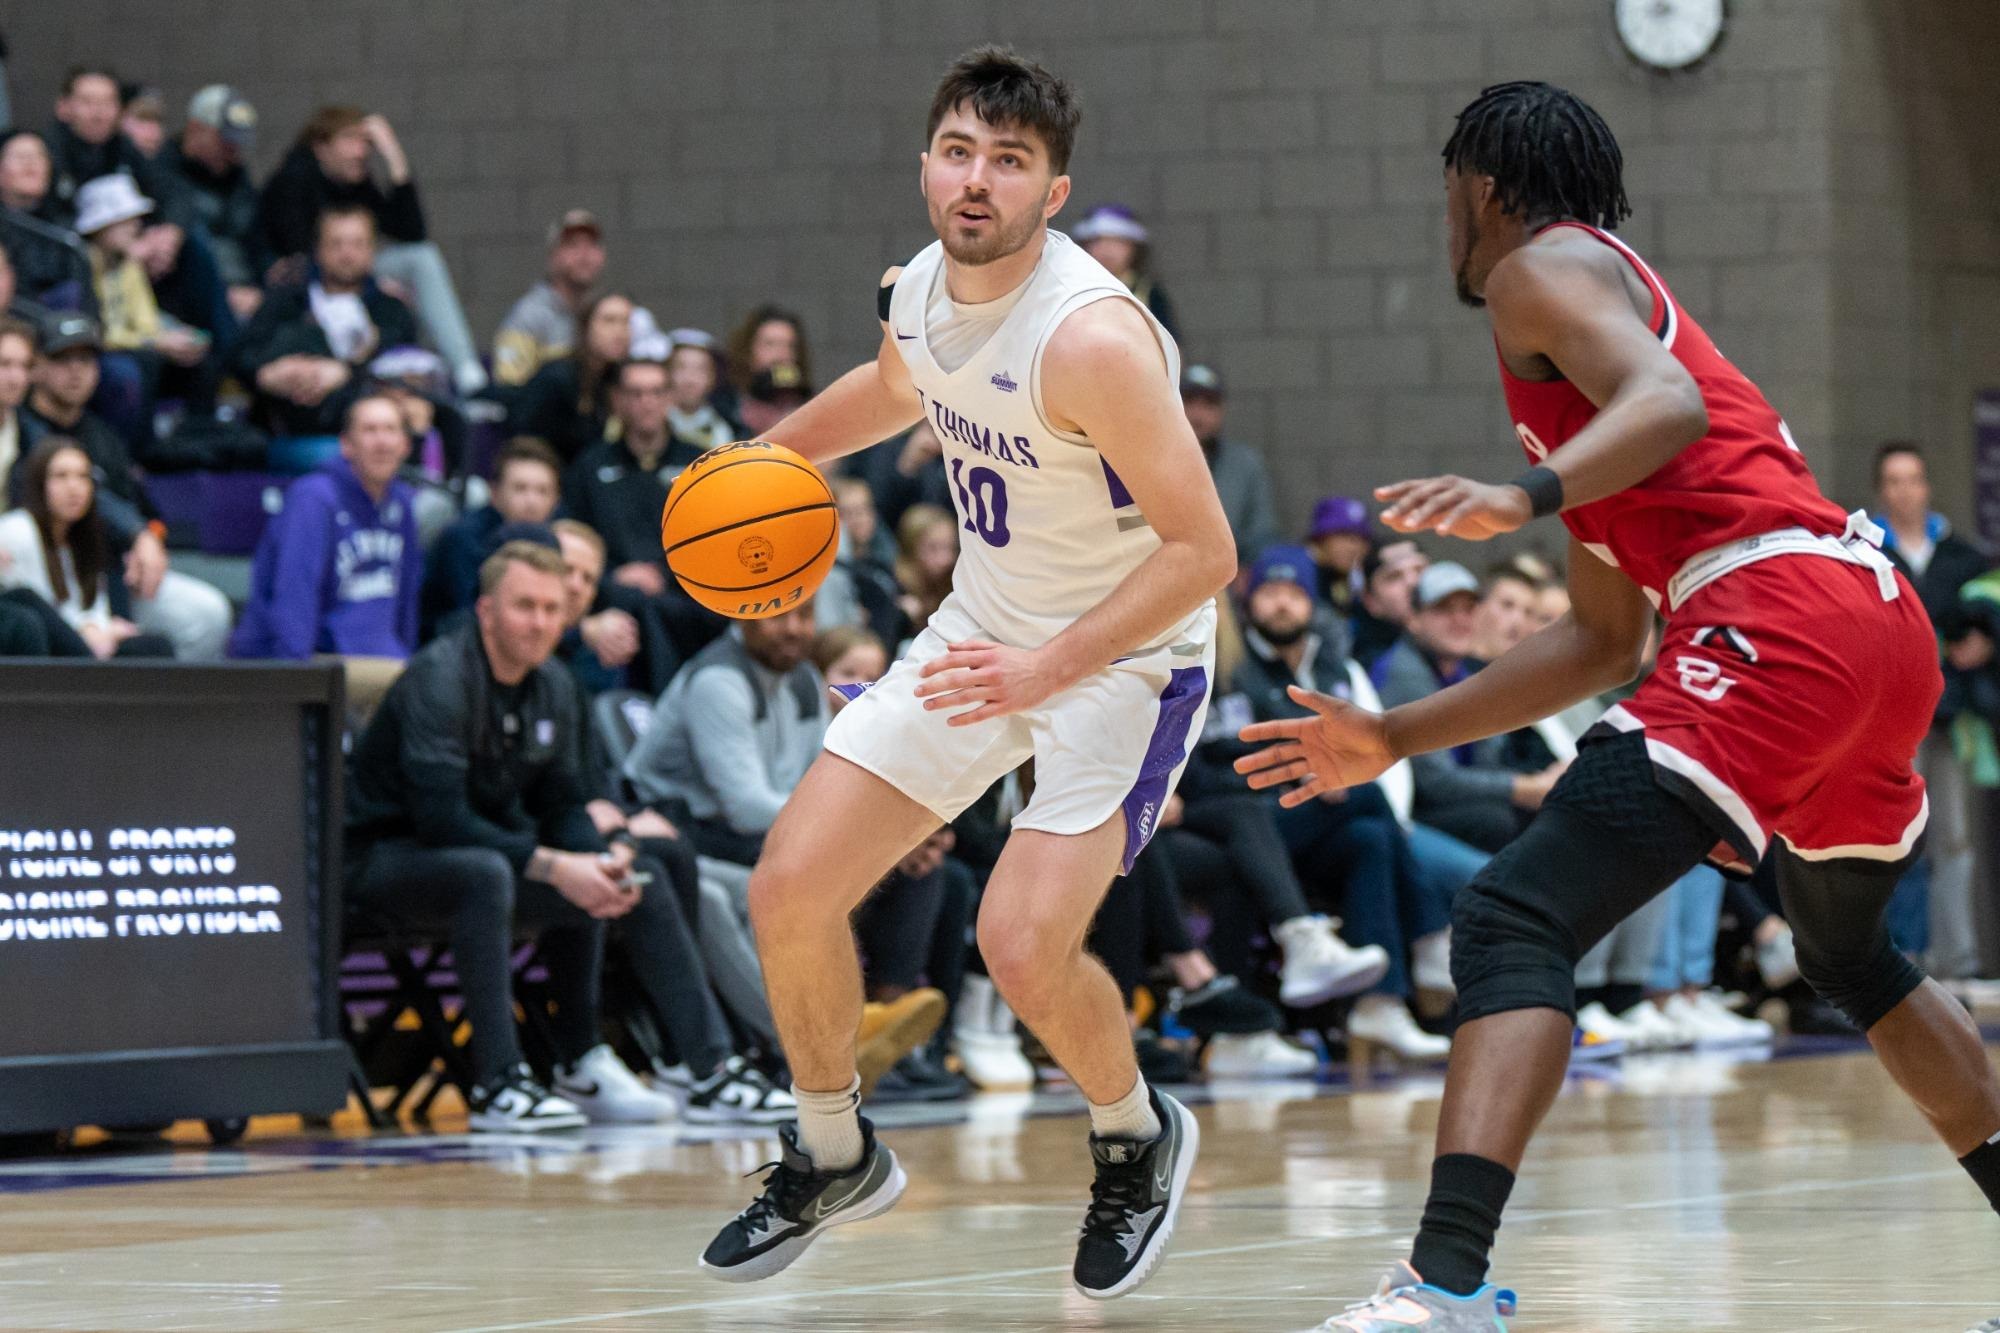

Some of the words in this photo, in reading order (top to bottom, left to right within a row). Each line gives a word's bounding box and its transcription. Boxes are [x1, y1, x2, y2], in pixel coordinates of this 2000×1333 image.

[691, 440, 772, 473] NCAA
[931, 399, 1040, 469] THOMAS
[951, 457, 1011, 548] 10
